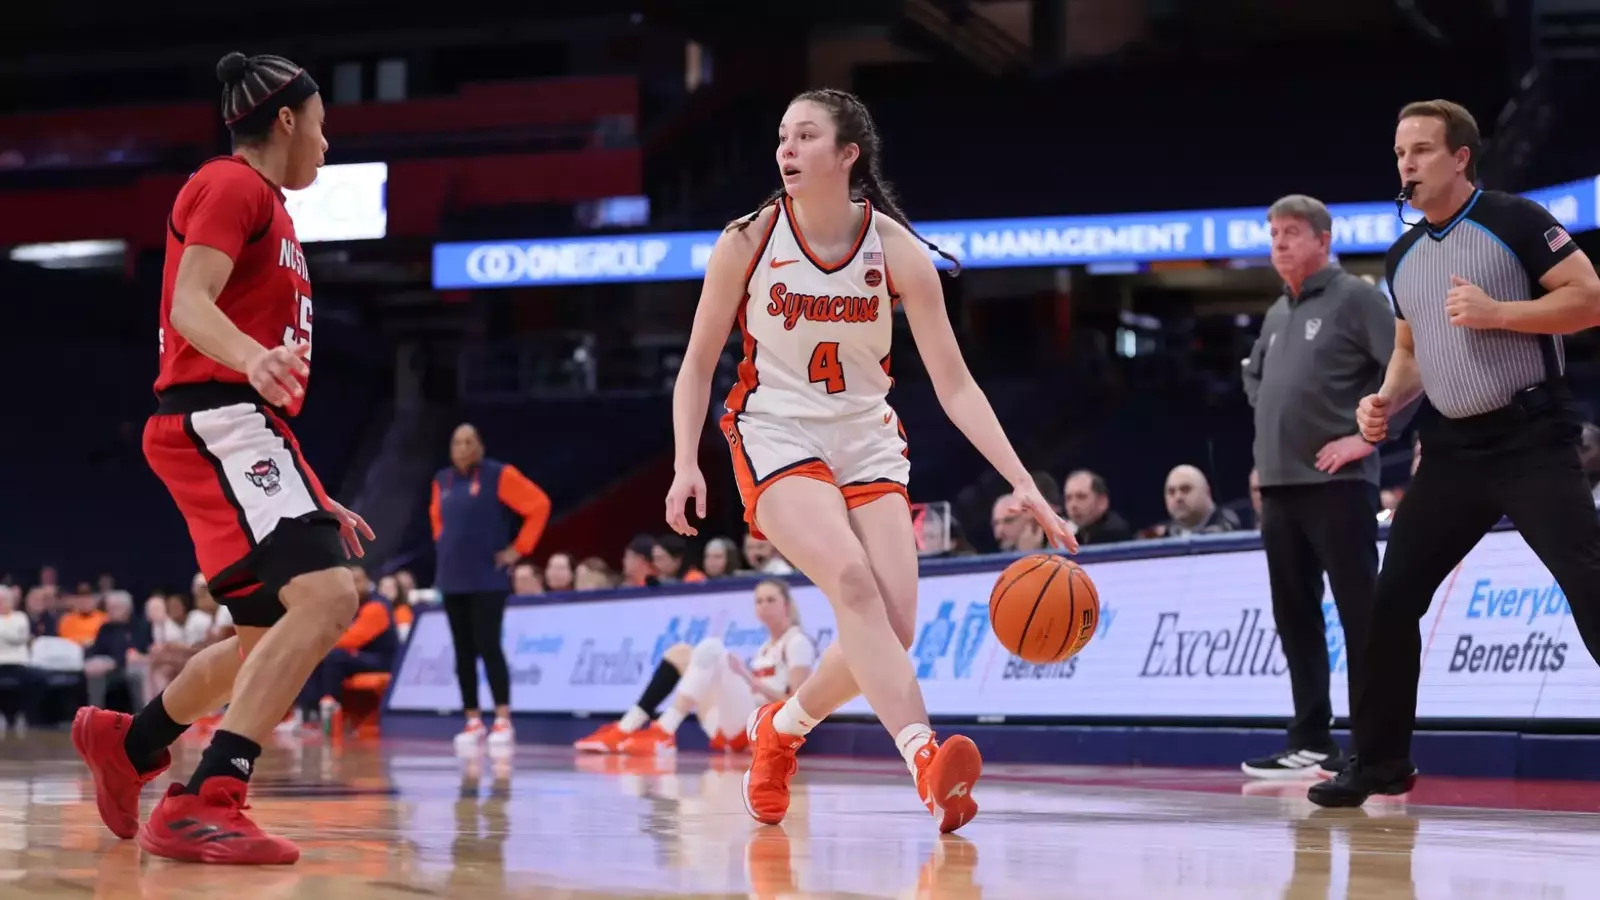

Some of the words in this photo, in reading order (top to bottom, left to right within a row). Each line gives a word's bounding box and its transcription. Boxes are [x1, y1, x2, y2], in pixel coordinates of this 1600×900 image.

[526, 240, 669, 280] ONEGROUP
[970, 222, 1191, 259] MANAGEMENT
[767, 282, 880, 331] Syracuse
[808, 341, 847, 394] 4
[1448, 631, 1568, 673] Benefits
